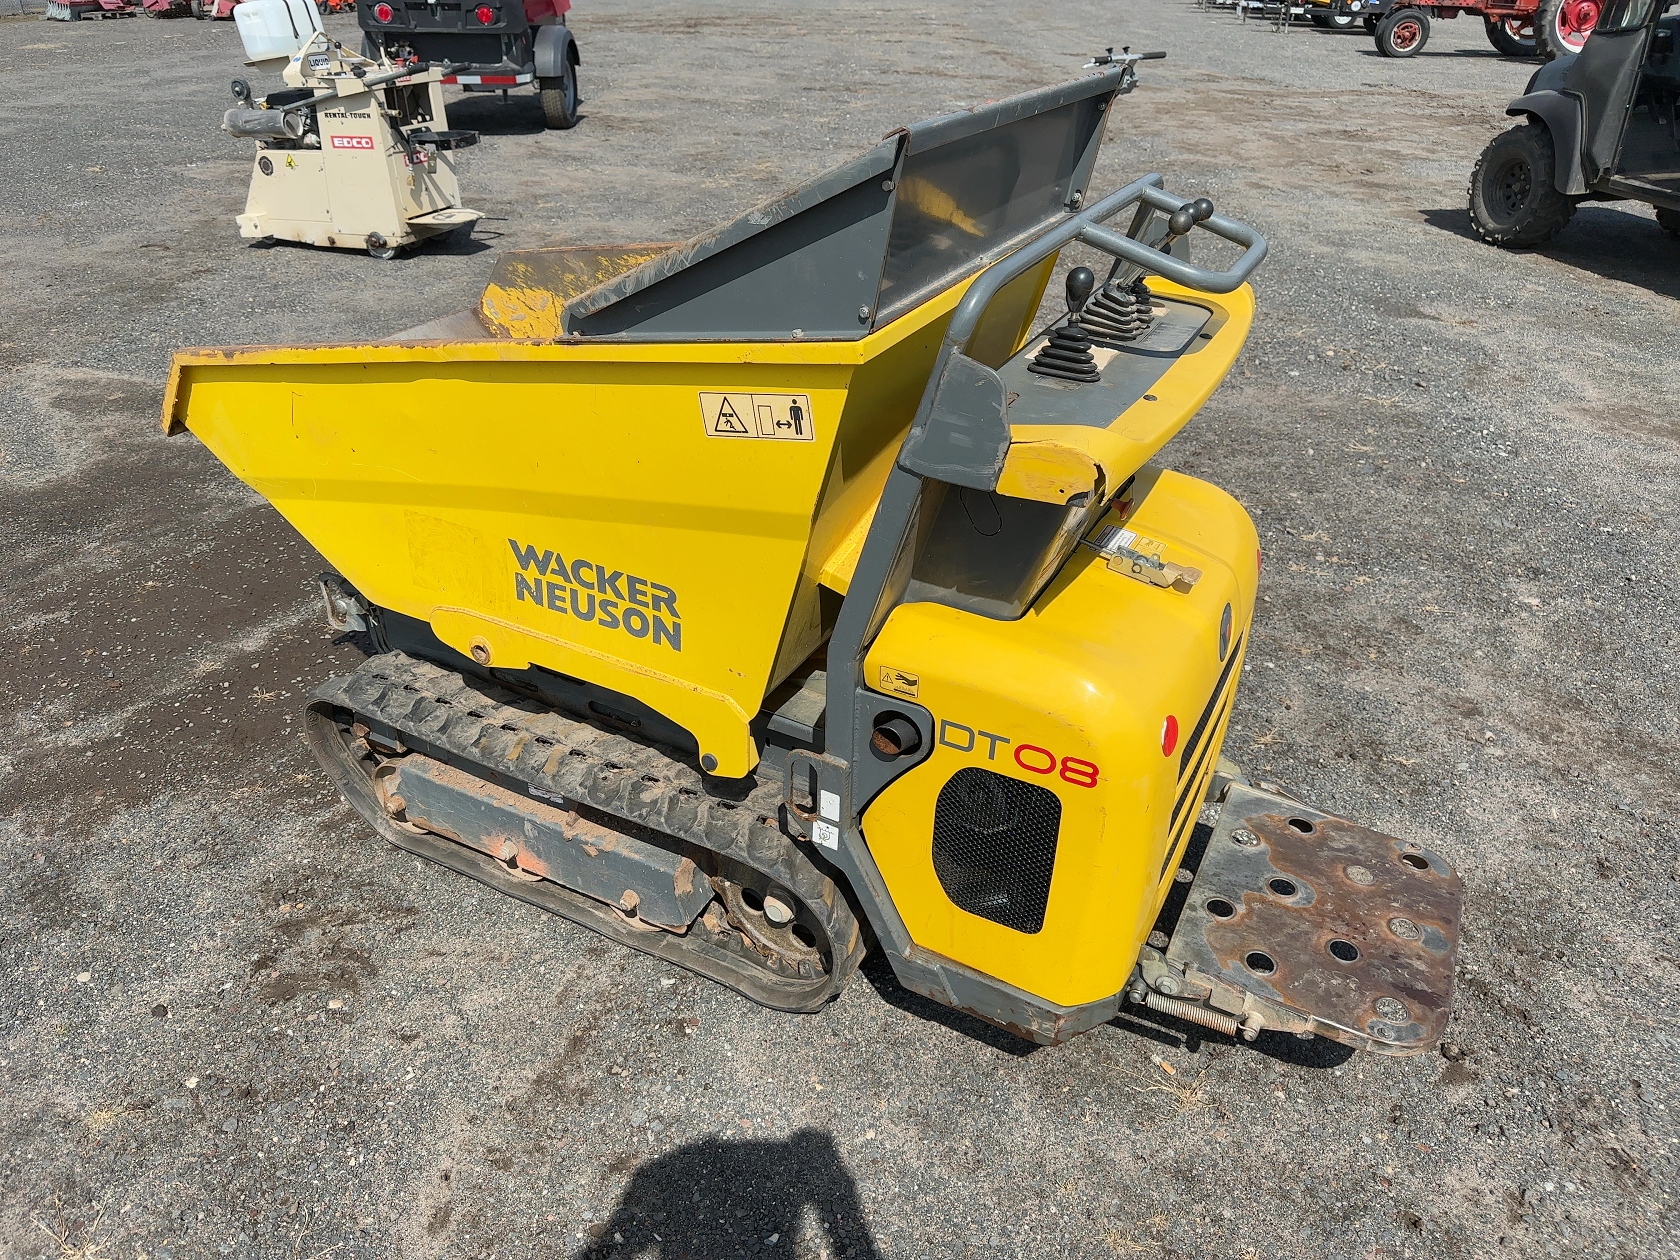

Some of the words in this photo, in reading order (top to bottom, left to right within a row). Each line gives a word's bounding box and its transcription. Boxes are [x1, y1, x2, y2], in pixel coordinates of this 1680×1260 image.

[309, 57, 329, 67] LIQUID
[332, 137, 372, 148] EDCO
[508, 538, 681, 619] WACKER
[515, 572, 682, 652] NEUSON
[939, 719, 1099, 788] DT08
